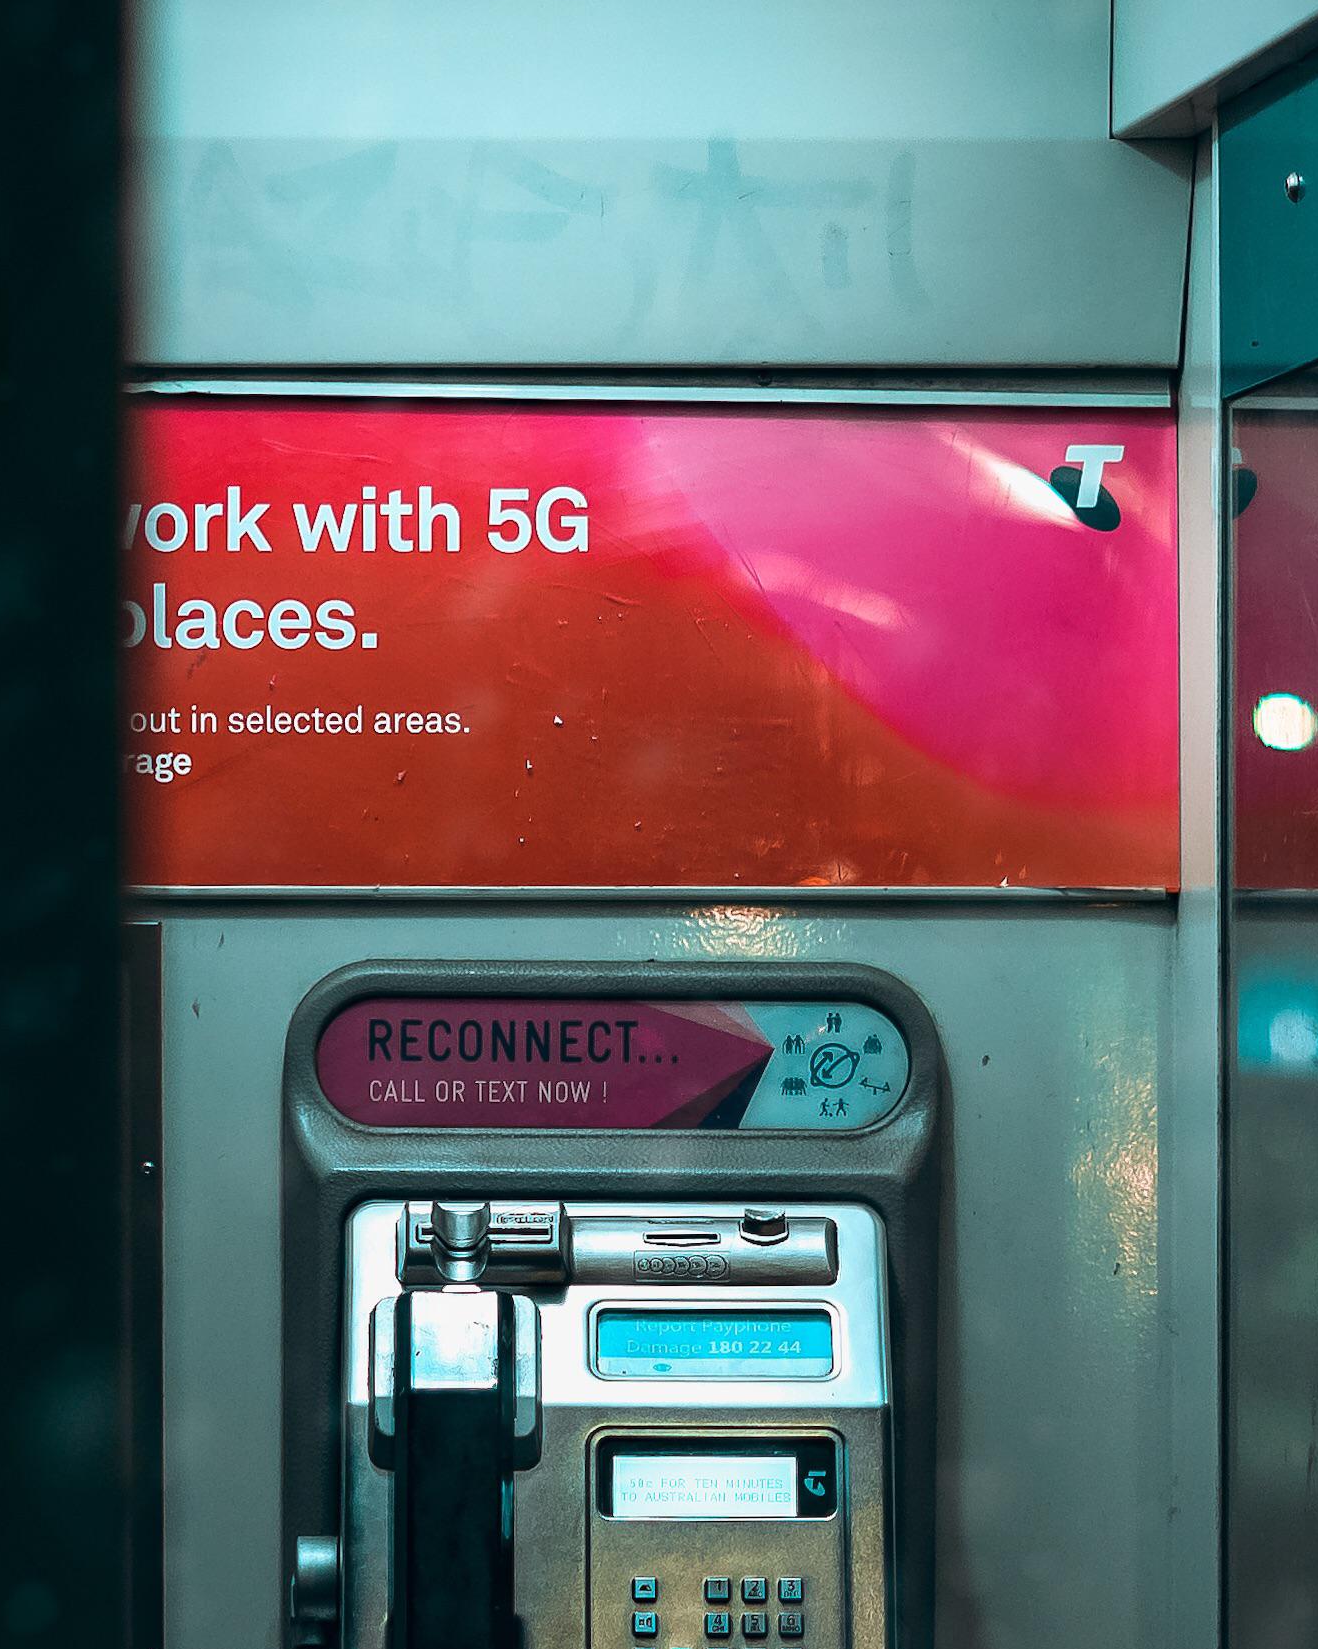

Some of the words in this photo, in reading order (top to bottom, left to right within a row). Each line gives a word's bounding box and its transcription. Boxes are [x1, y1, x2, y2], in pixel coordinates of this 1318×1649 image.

[292, 486, 461, 552] with
[486, 486, 589, 553] 5G
[131, 707, 180, 733] out
[190, 705, 218, 733] in
[228, 705, 363, 734] selected
[373, 711, 471, 734] areas.
[368, 1019, 679, 1063] RECONNECT...
[369, 1079, 426, 1103] CALL
[435, 1080, 465, 1103] OR
[474, 1080, 528, 1103] TEXT
[538, 1080, 591, 1103] NOW
[635, 1319, 697, 1335] Report
[702, 1319, 793, 1335] Payphone
[627, 1339, 702, 1356] Damage
[709, 1340, 743, 1354] 180
[749, 1340, 772, 1354] 22
[778, 1340, 802, 1354] 44
[661, 1478, 686, 1489] FOR
[695, 1478, 718, 1489] TEN
[726, 1478, 783, 1489] MINUTES
[621, 1491, 637, 1502] TO
[645, 1491, 726, 1502] AUSTRALIAN
[734, 1491, 792, 1503] MOBILES
